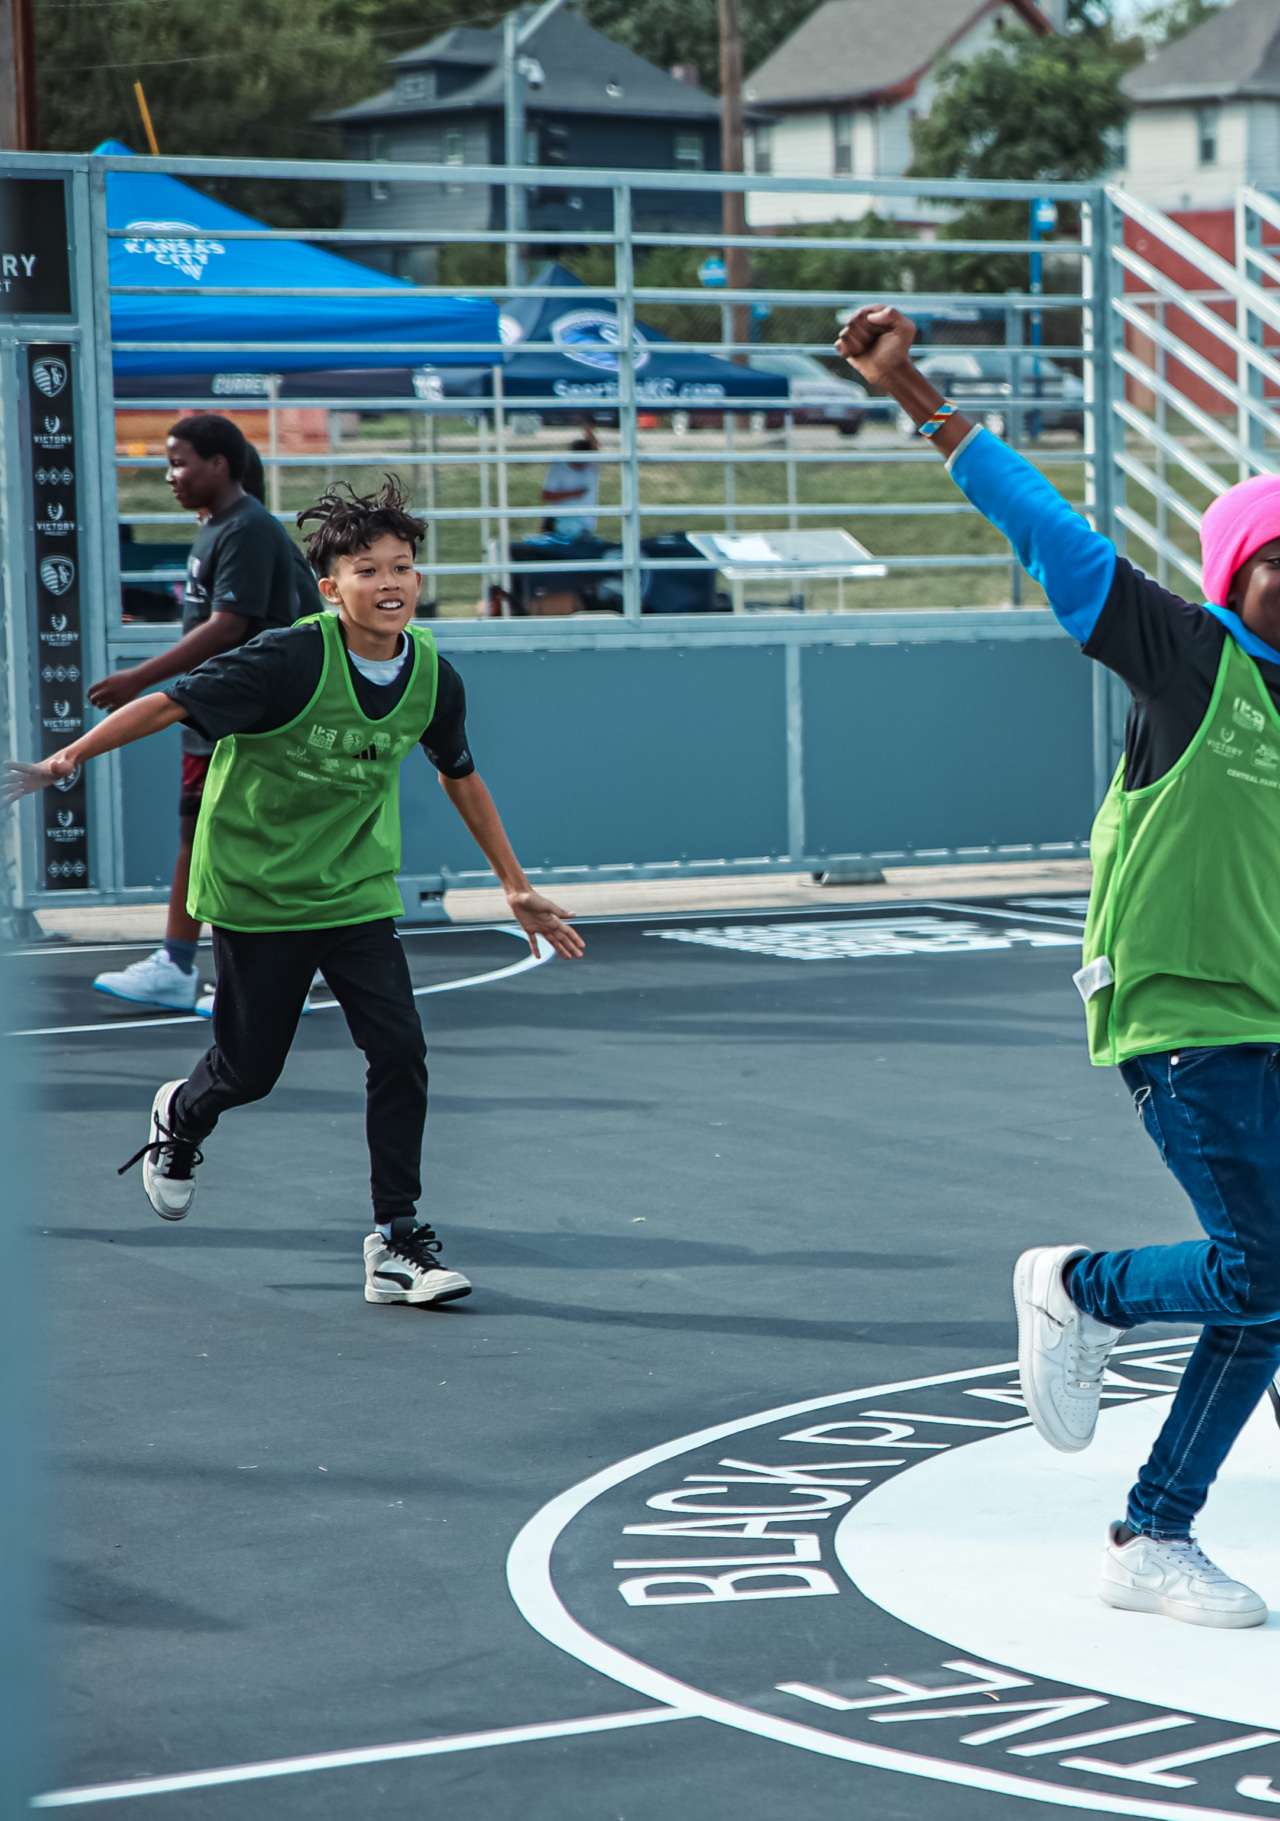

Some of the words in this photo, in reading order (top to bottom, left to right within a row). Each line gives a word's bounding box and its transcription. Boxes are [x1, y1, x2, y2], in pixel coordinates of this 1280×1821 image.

[34, 434, 73, 445] VICTORY
[36, 521, 76, 532] VICTORY
[40, 633, 79, 643] VICTORY
[43, 718, 82, 729] VICTORY
[47, 827, 85, 838] VICTORY
[613, 1457, 907, 1608] BLACK
